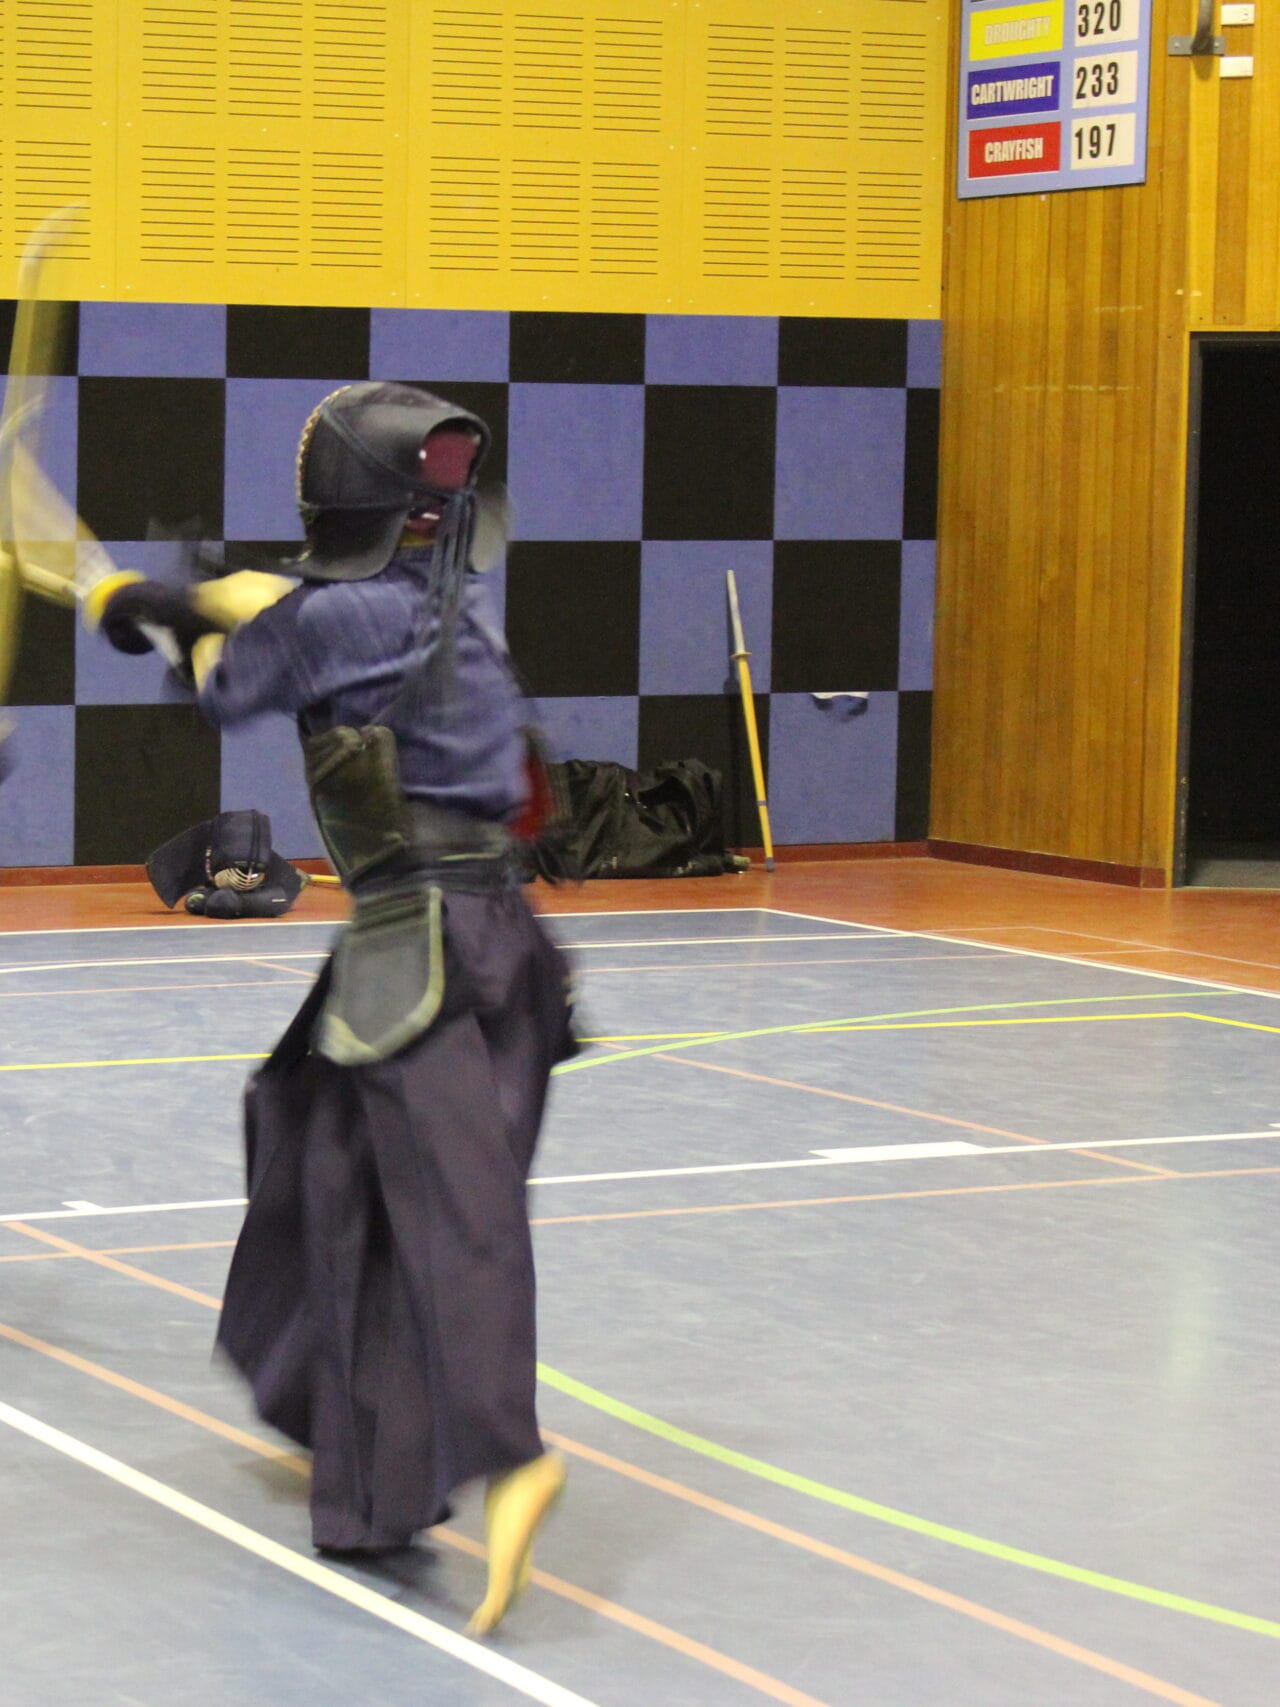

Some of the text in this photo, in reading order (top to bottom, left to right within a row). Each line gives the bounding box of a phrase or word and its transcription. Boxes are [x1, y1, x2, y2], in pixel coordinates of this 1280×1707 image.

[1078, 0, 1121, 37] 320
[971, 61, 1119, 105] CARTWRIGHT 233
[984, 123, 1117, 163] CRAYFISH 197
